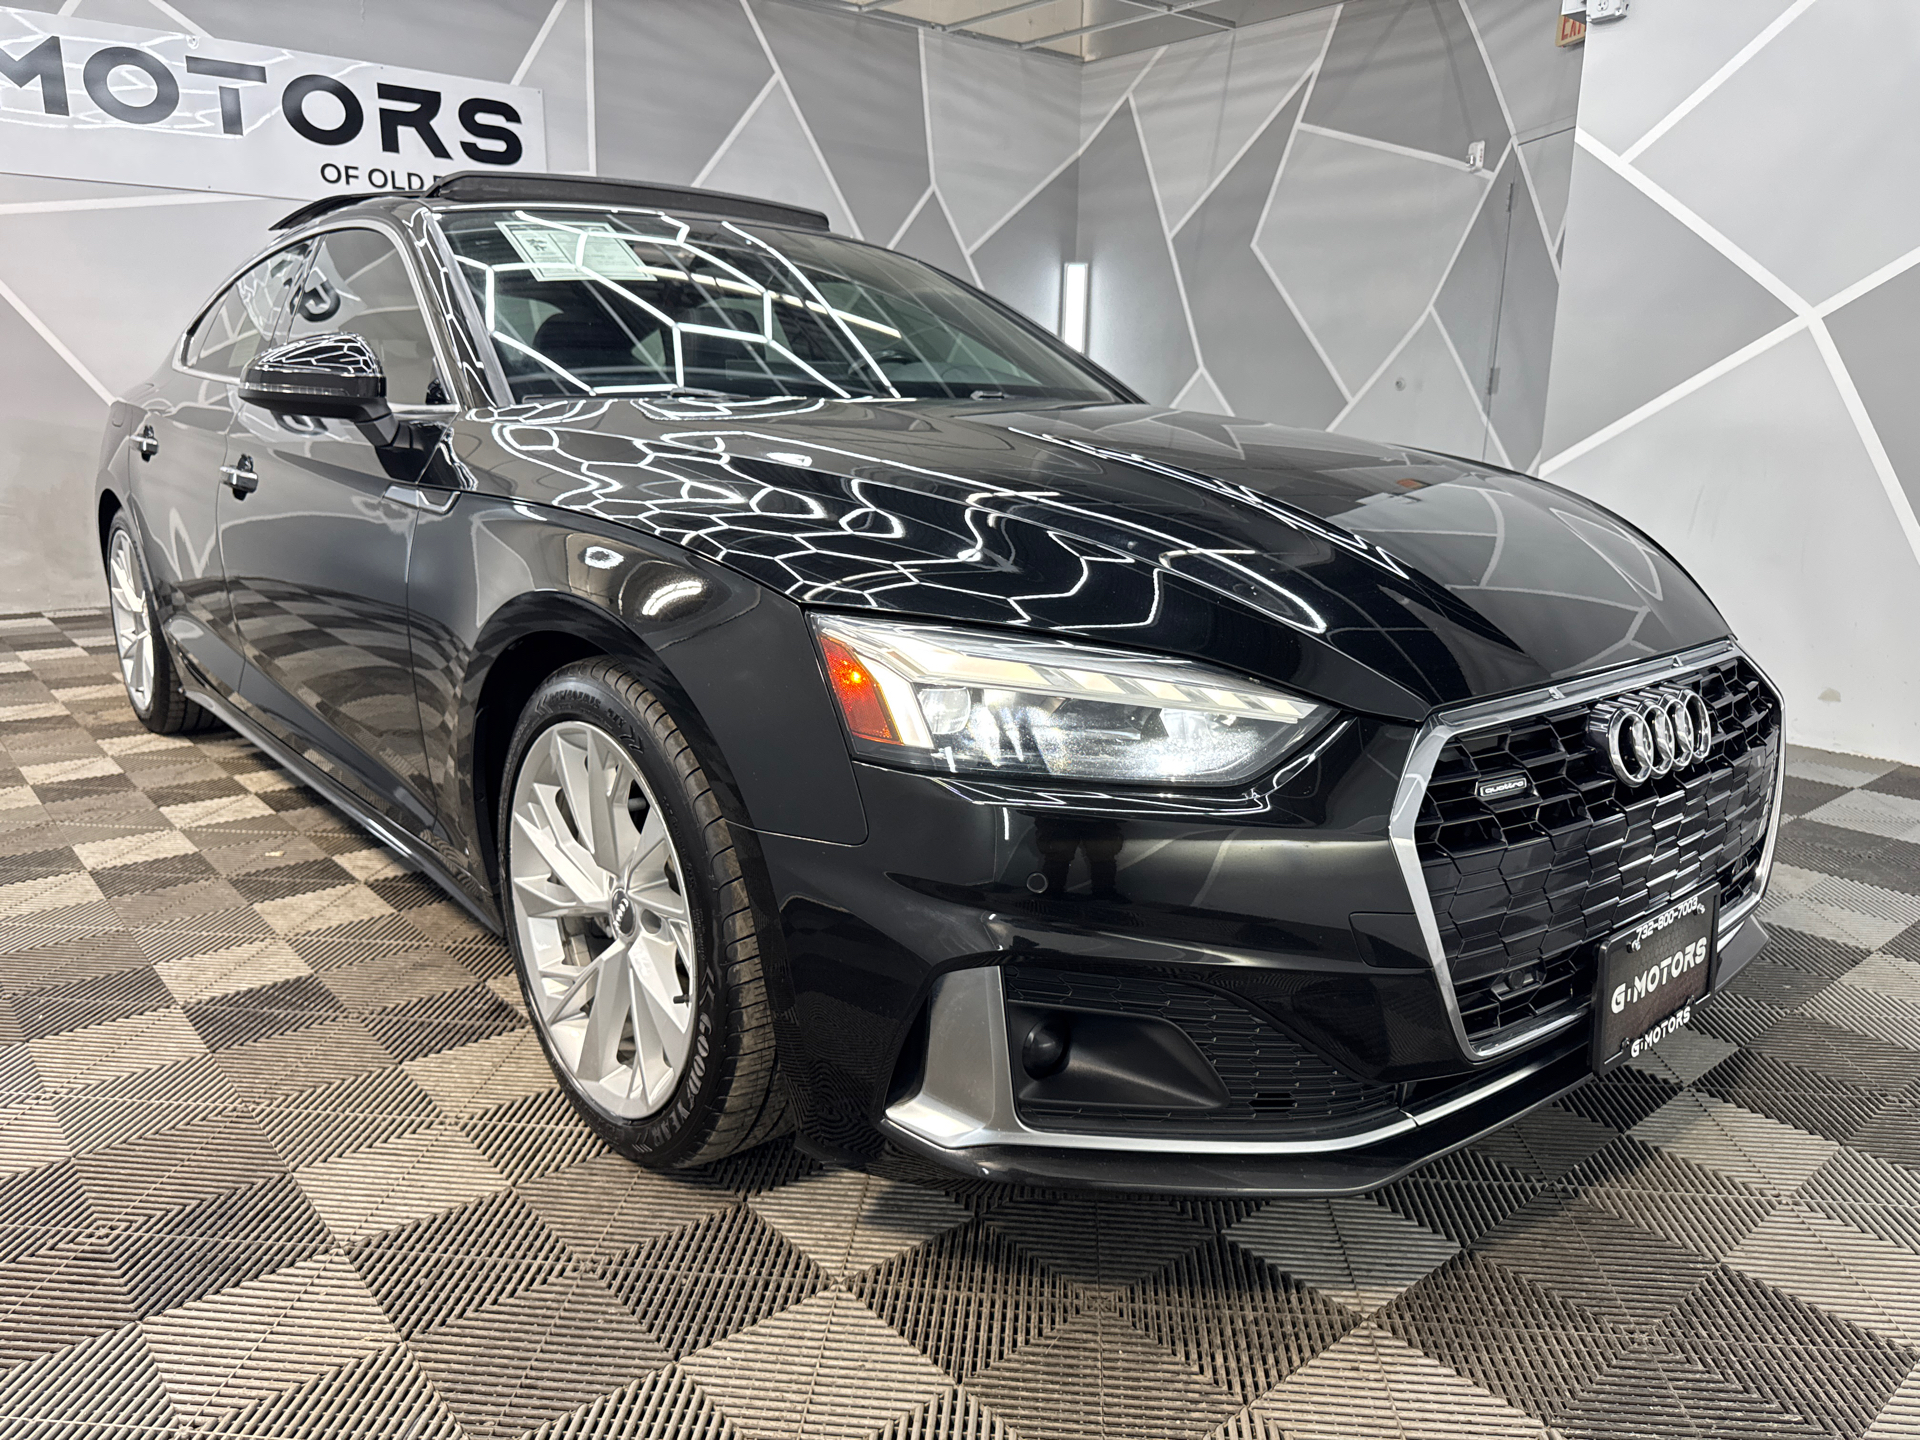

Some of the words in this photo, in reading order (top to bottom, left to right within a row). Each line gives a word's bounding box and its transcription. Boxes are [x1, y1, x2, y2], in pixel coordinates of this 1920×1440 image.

[1561, 15, 1586, 41] EX
[0, 36, 523, 165] MOTORS
[320, 163, 359, 186] OF
[368, 168, 424, 190] OLD
[1484, 780, 1524, 794] quattro
[1636, 896, 1698, 941] 732-800-7003
